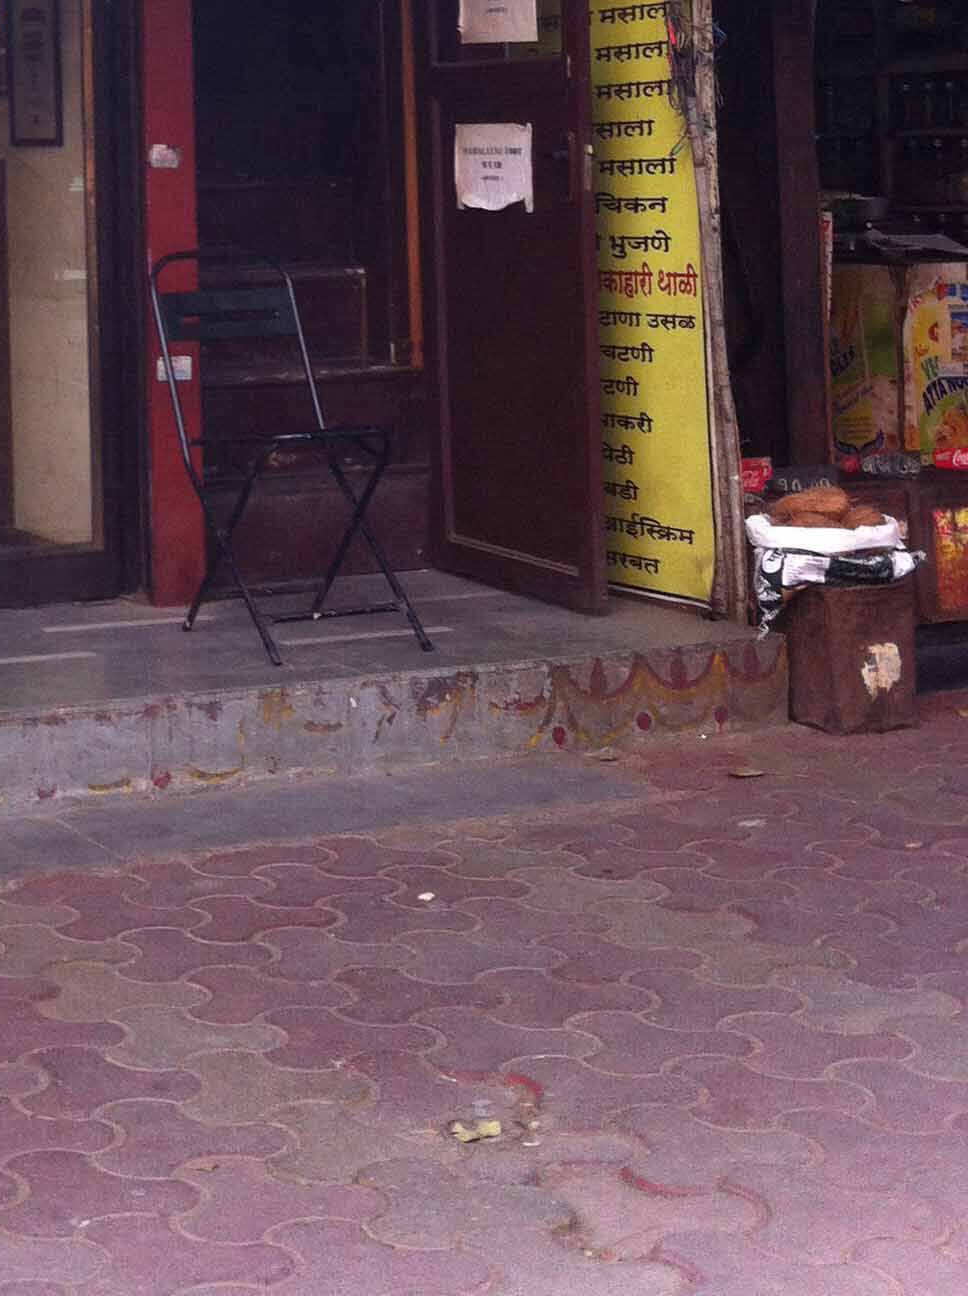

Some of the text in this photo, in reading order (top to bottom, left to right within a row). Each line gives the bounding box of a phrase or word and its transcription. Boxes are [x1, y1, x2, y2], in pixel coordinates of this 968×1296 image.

[598, 1, 671, 24] मसाल
[594, 79, 672, 101] मसाला
[593, 119, 655, 140] साला
[598, 156, 677, 177] मसाला
[594, 191, 669, 215] चिकन
[609, 229, 672, 259] भुजणे
[598, 262, 699, 298] काहारी थाळी
[599, 310, 697, 331] टाणा उसळ
[600, 375, 639, 397] टणी
